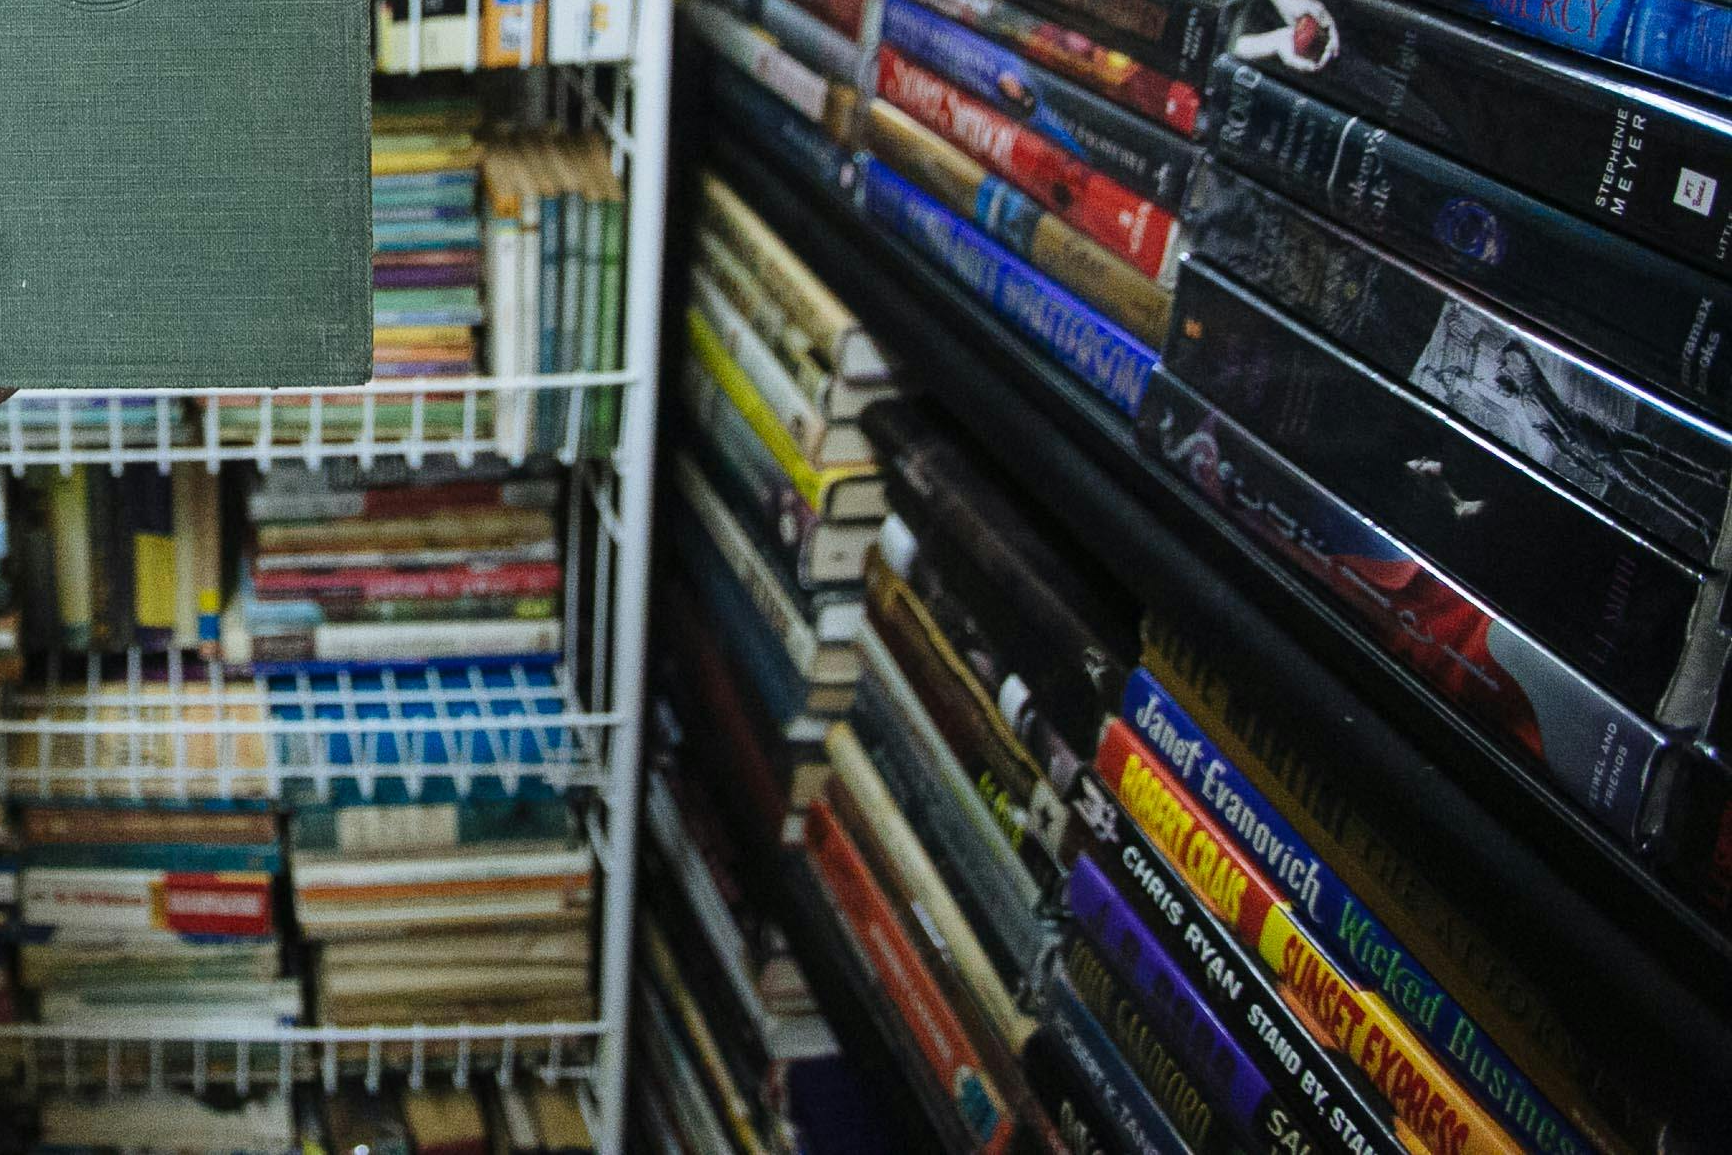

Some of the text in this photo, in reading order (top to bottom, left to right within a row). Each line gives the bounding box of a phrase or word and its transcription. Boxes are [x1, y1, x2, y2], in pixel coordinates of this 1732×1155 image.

[1595, 107, 1630, 208] STEPHENIE
[1609, 113, 1648, 216] MEYER
[1599, 721, 1620, 755] AND
[1602, 745, 1630, 811] FRIENDS
[1119, 752, 1194, 867] ROBERT
[1183, 834, 1250, 926] CRAIS
[1278, 932, 1366, 1066] SUNSET
[1134, 692, 1204, 781] Janet
[1198, 749, 1326, 925] Evanovich
[1335, 895, 1441, 1036] Wicked
[1120, 844, 1185, 925] CHRIS
[1182, 921, 1245, 1001] RYAN
[1245, 1001, 1304, 1078] STAND
[1299, 1070, 1331, 1117] BY,
